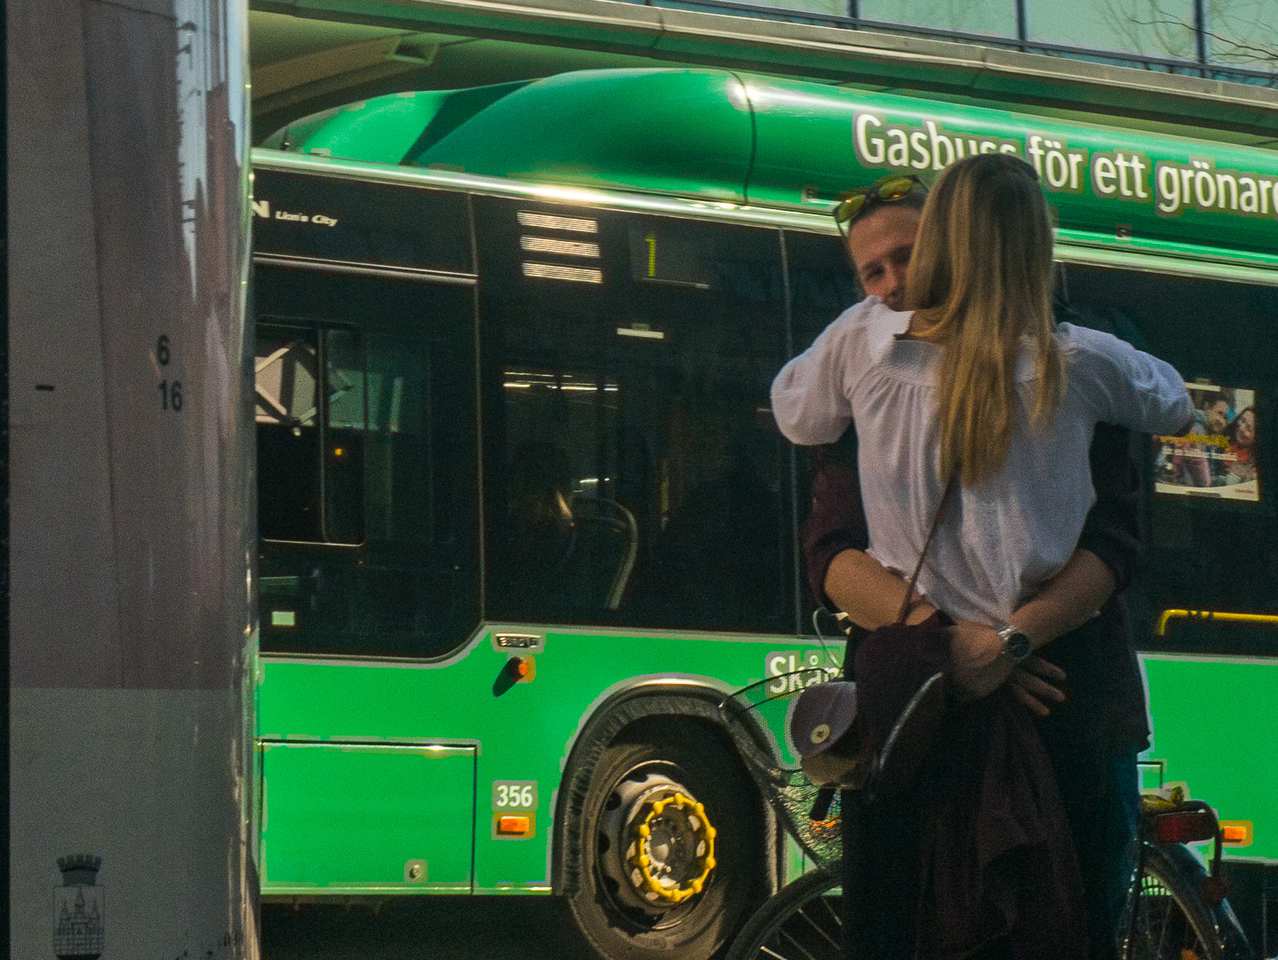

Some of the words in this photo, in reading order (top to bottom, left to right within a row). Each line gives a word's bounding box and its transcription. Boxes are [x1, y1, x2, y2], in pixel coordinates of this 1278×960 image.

[1029, 136, 1083, 189] för
[1093, 153, 1148, 198] ett
[1158, 160, 1278, 214] grönar
[157, 335, 171, 366] 6
[159, 380, 183, 412] 16
[770, 654, 844, 693] Skån
[496, 785, 533, 807] 356
